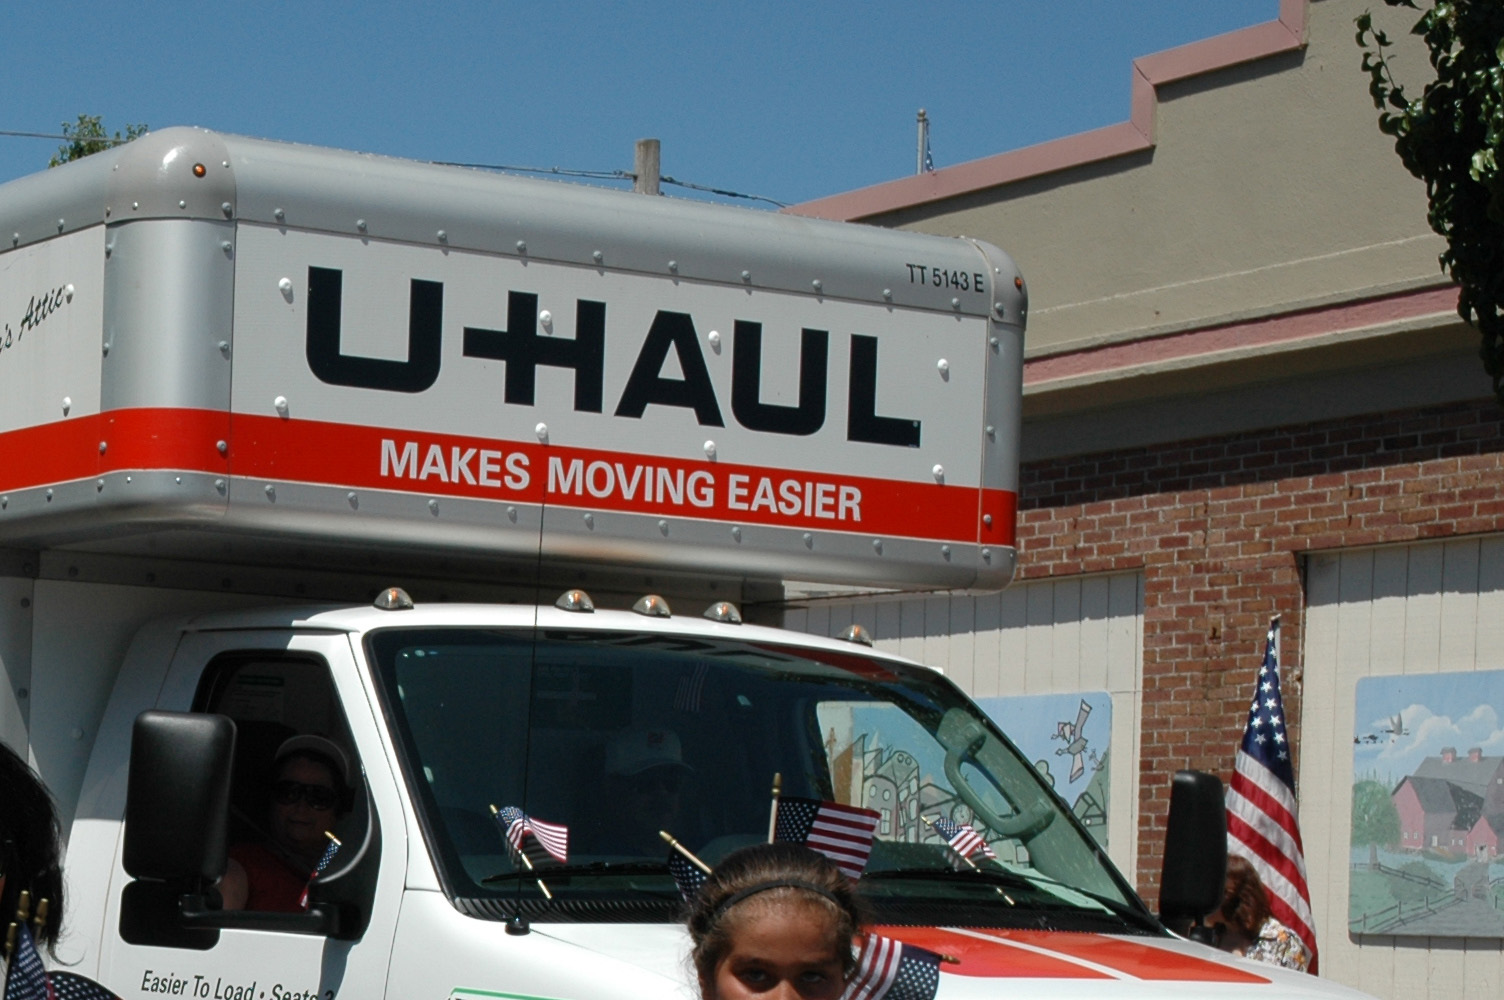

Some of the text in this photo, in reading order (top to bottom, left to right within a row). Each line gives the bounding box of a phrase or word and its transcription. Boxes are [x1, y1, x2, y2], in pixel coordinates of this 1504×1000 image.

[906, 263, 984, 292] TT 5143 E
[18, 287, 65, 341] Attic
[306, 265, 921, 448] U-HAUL
[379, 439, 863, 522] MAKES MOVING EASIER
[141, 970, 188, 996] Easier
[193, 975, 210, 999] To
